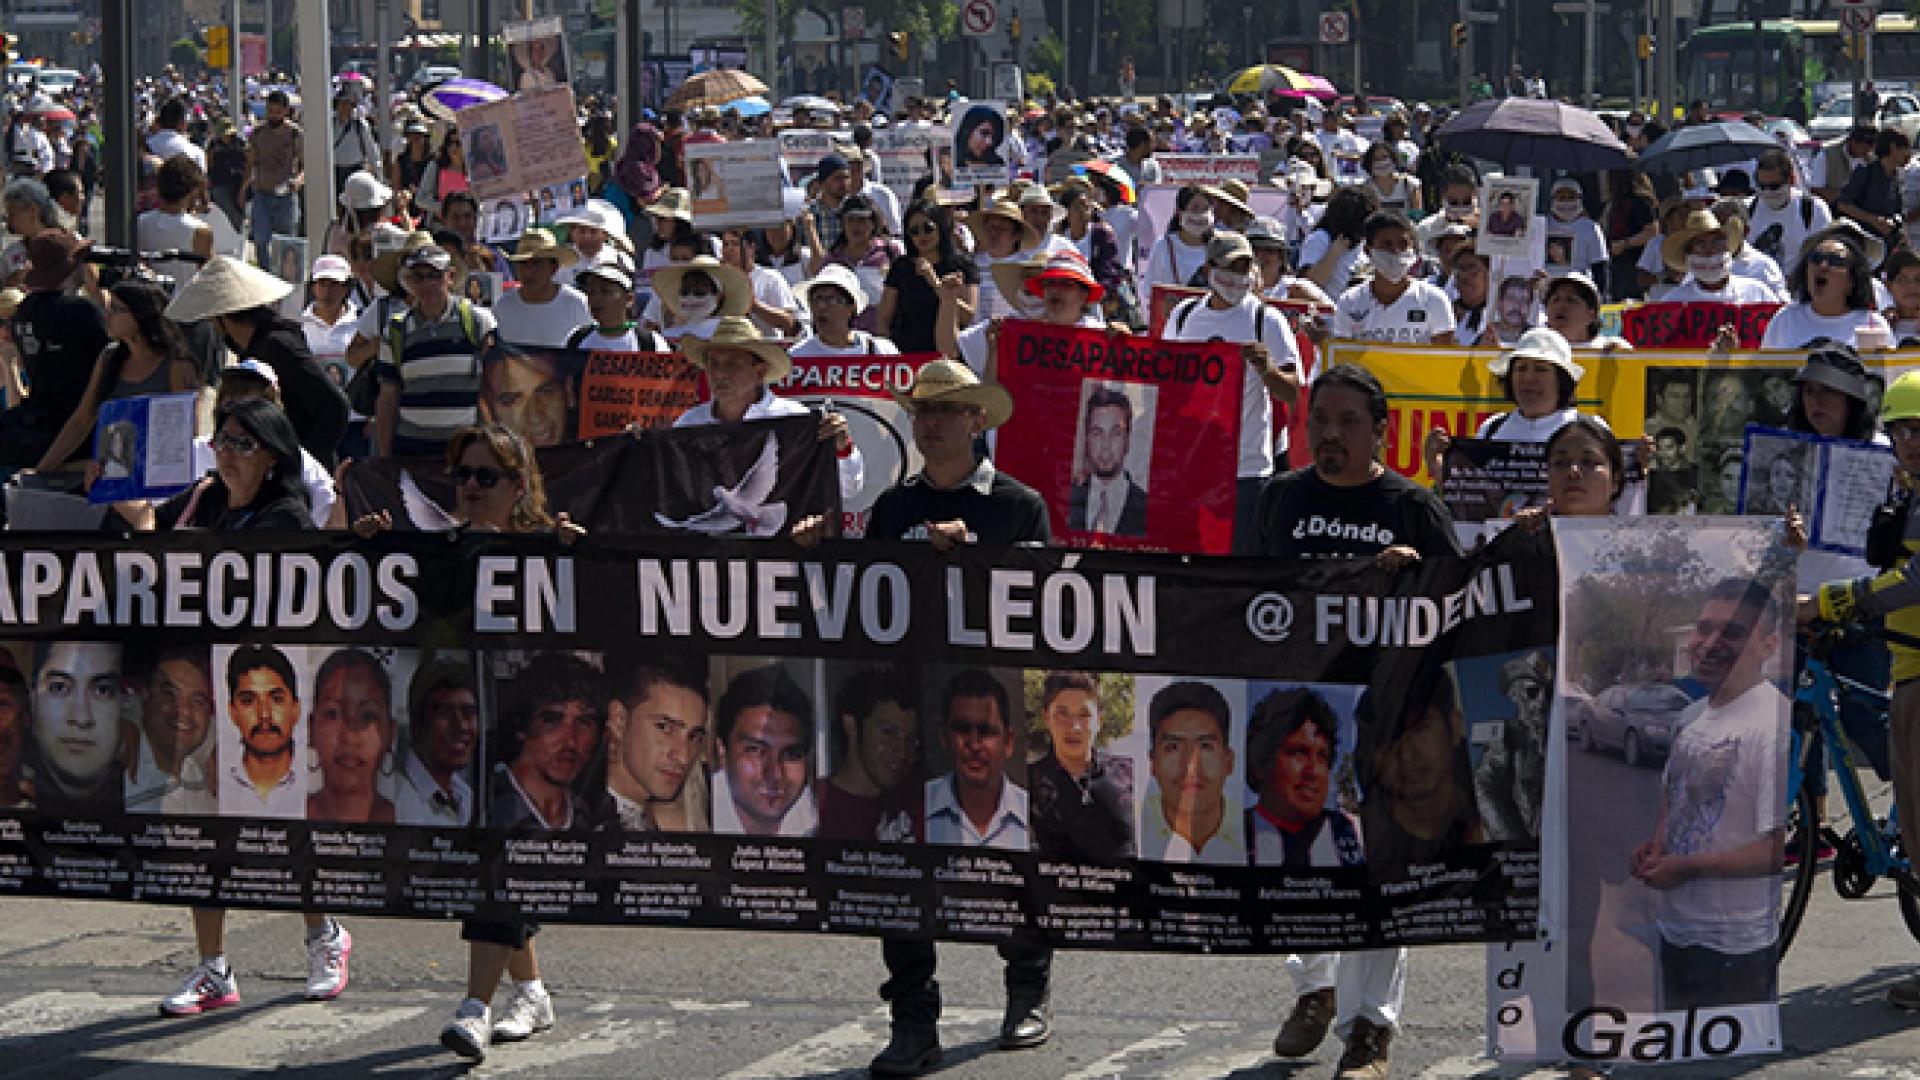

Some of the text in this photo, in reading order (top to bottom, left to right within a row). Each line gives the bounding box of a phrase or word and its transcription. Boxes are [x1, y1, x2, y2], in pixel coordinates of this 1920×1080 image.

[1017, 334, 1224, 385] DESAPARECIDO
[1292, 515, 1394, 545] ¿Dónde
[474, 557, 577, 633] EN
[637, 558, 911, 644] NUEVO
[946, 553, 1157, 656] LEÓN
[1246, 590, 1294, 642] @
[1315, 562, 1534, 648] FUNDENL
[1562, 1004, 1742, 1062] Galo
